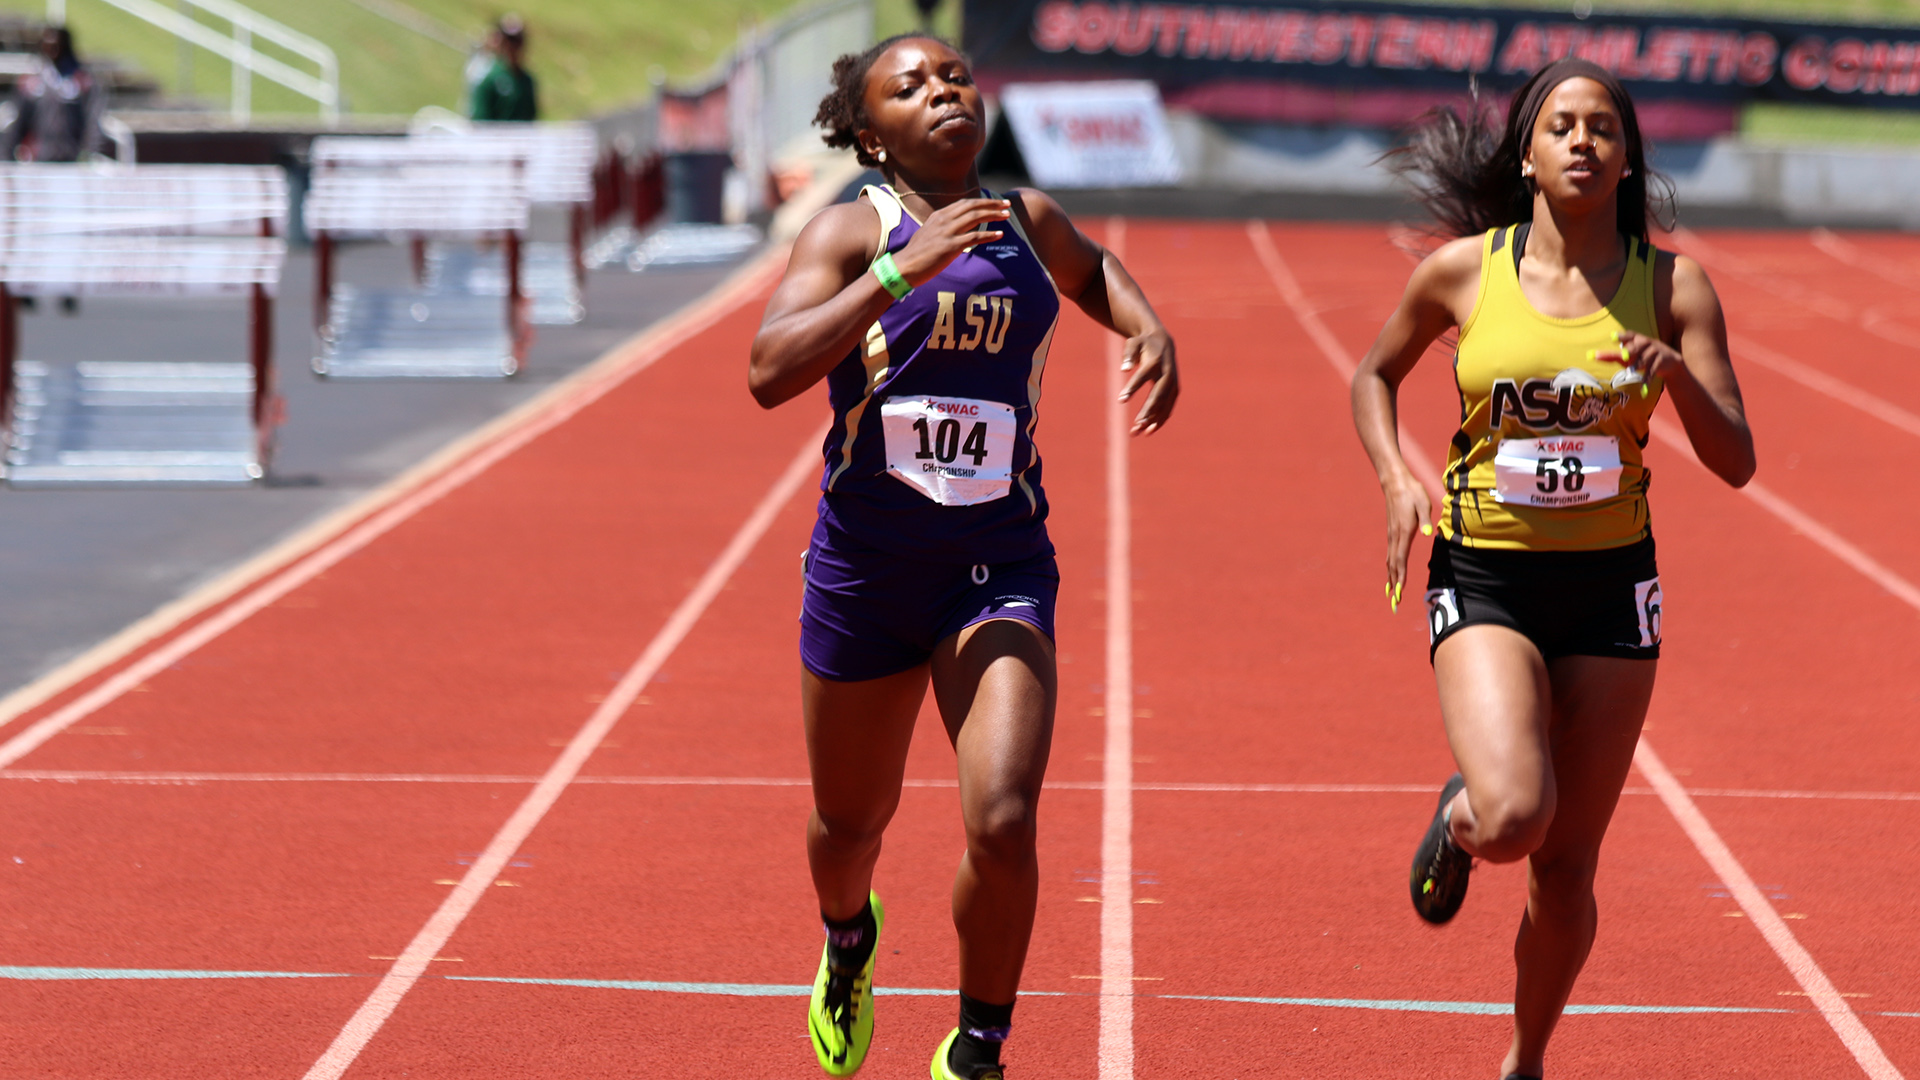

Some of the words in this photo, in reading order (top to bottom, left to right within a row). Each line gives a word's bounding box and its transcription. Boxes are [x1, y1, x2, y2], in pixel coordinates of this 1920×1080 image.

[1032, 1, 1497, 72] SOUTHWESTERN
[1500, 22, 1779, 86] ATHLETIC
[926, 291, 1013, 354] ASU
[937, 403, 979, 416] SWAC
[1490, 377, 1597, 433] ASU
[912, 418, 988, 466] 104
[1547, 441, 1585, 453] SWAC
[1536, 456, 1585, 493] 58
[1530, 493, 1590, 505] CHAMPIONSHIP
[1644, 581, 1660, 645] 6
